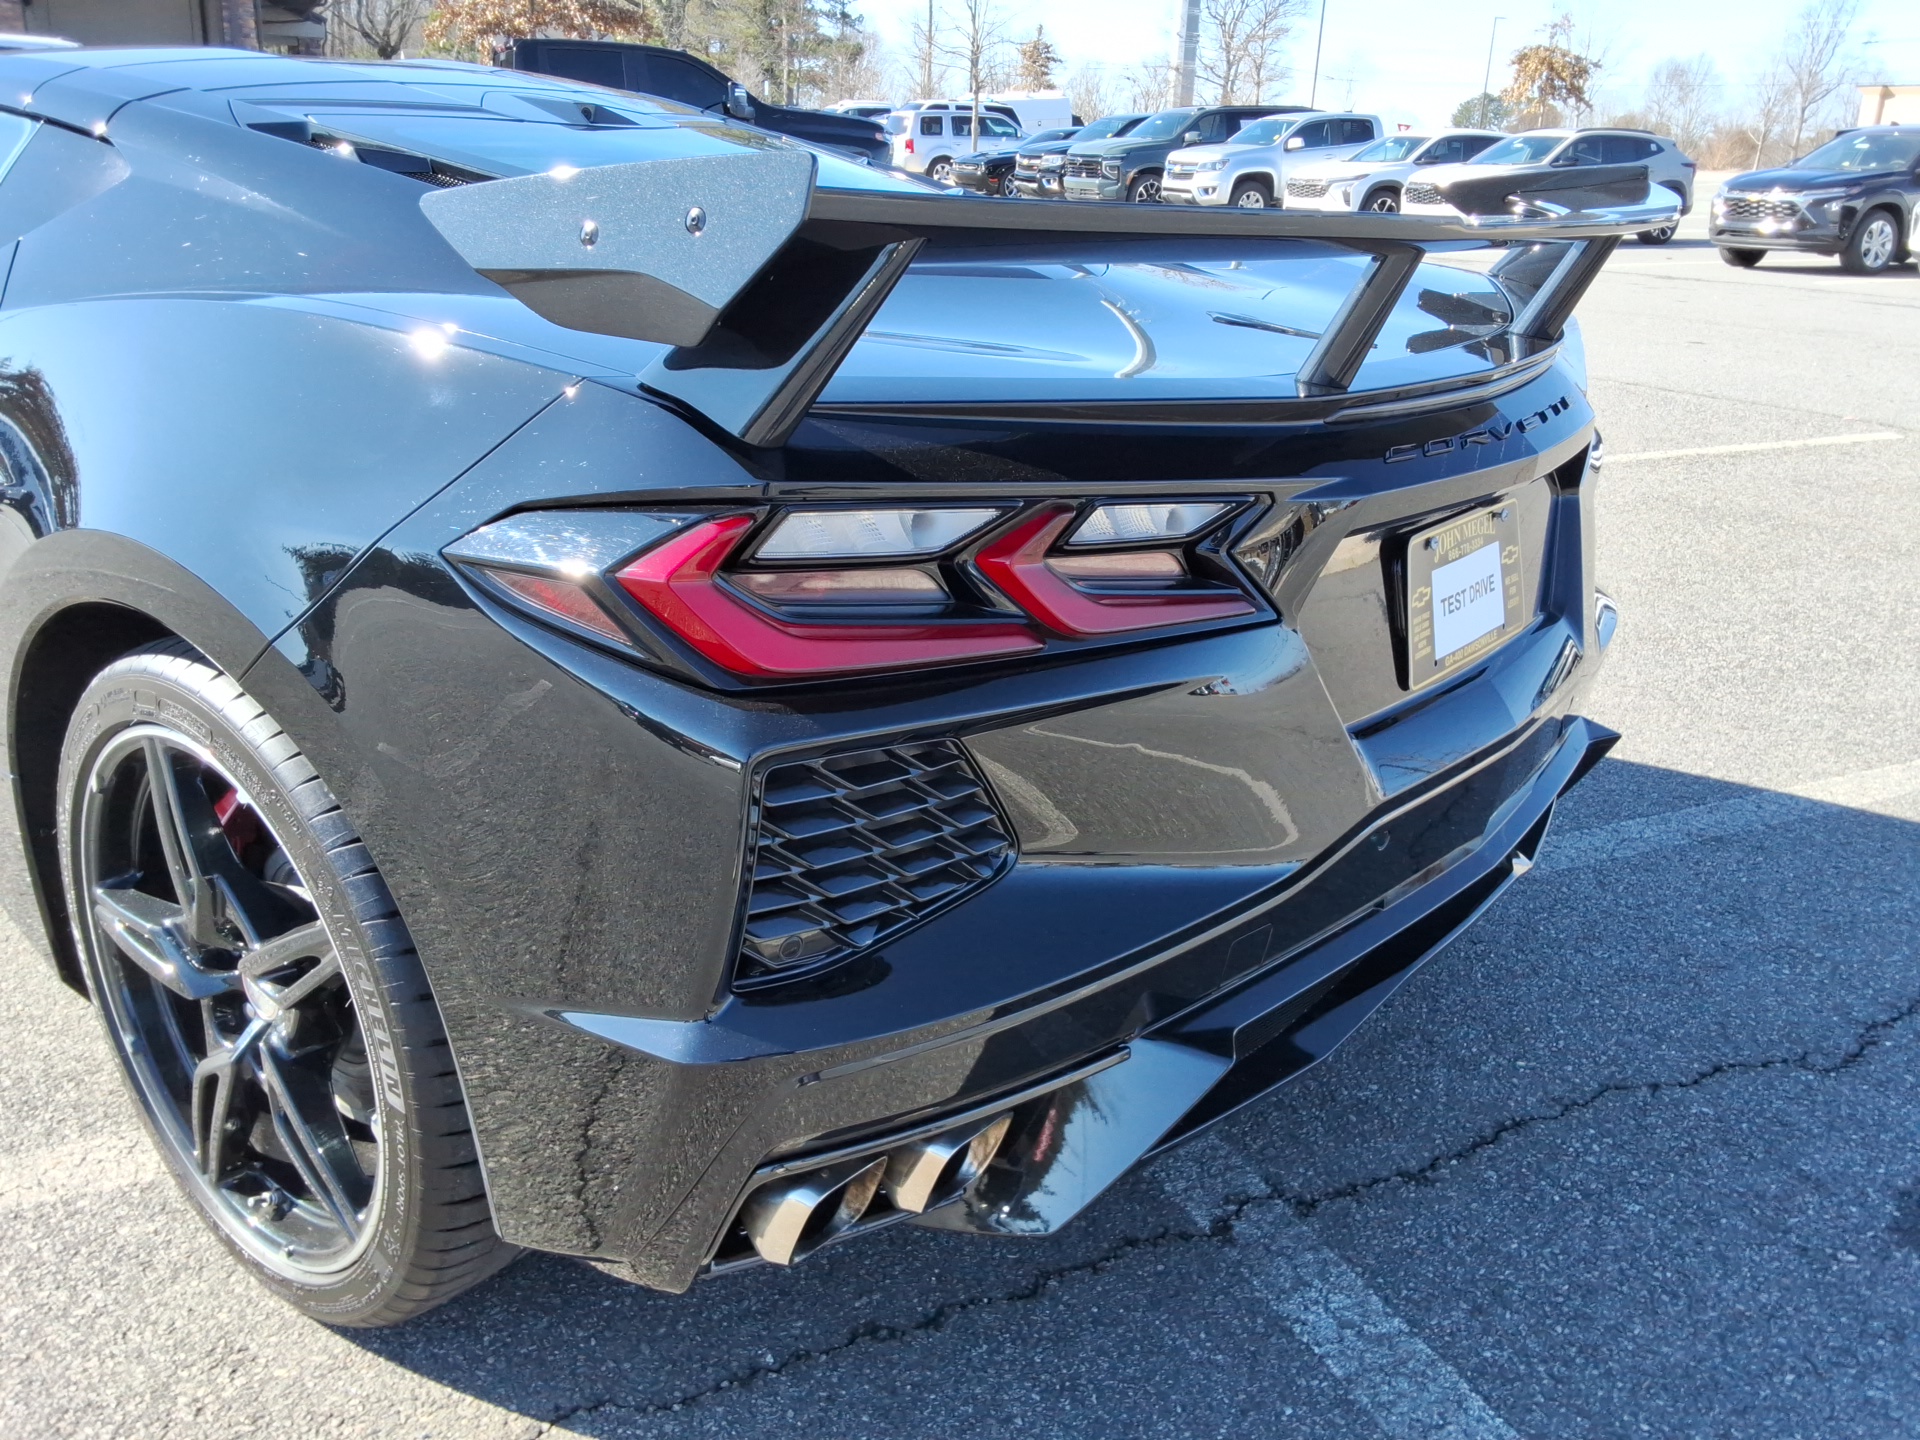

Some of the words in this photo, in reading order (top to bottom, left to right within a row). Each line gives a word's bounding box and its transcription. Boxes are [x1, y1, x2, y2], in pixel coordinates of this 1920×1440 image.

[1434, 526, 1461, 563] JOHN
[1462, 513, 1496, 539] MEGEL
[1440, 588, 1467, 617] TEST
[1469, 574, 1496, 603] DRIVE
[333, 914, 403, 1102] MICHELIN
[395, 1119, 405, 1169] PILOT
[396, 1169, 406, 1217] SPORT
